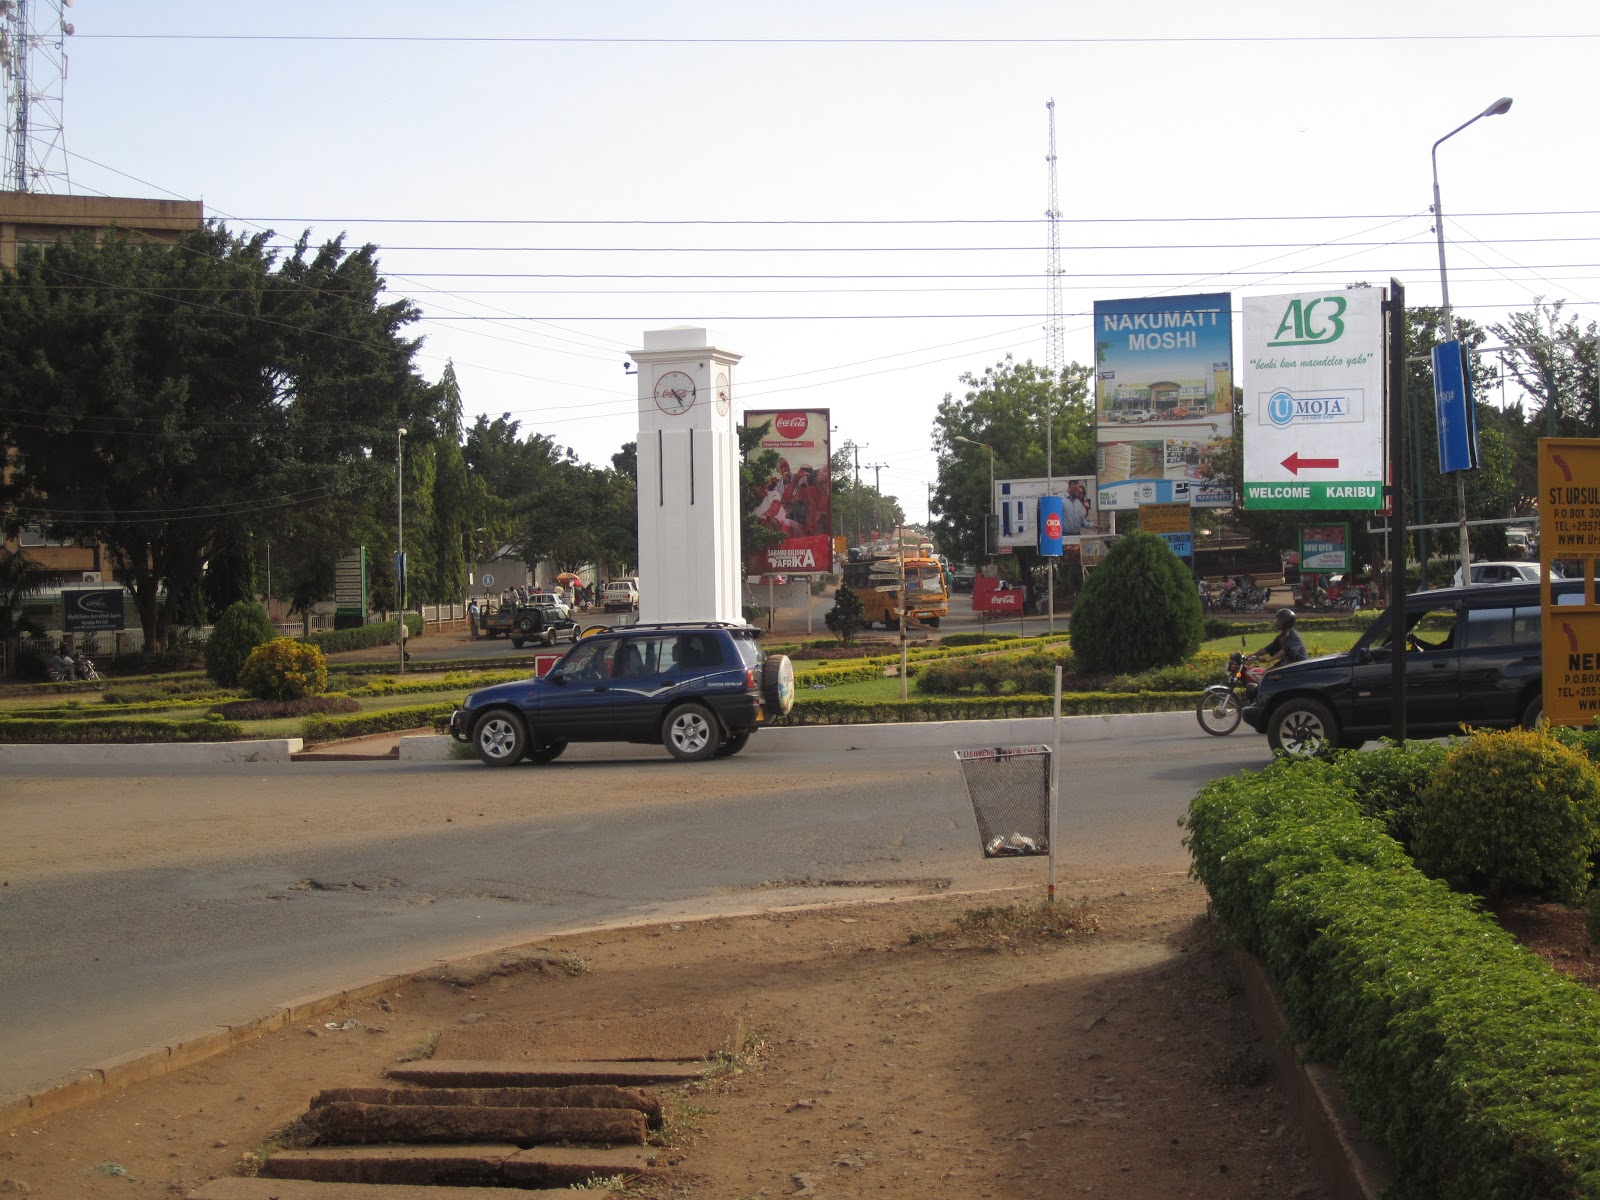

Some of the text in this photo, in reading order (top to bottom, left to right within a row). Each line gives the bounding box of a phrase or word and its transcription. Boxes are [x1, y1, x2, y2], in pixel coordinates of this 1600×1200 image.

[1104, 309, 1220, 331] NAKUMATT
[1129, 332, 1196, 350] MOSHI
[1280, 358, 1297, 368] kwa
[1249, 486, 1376, 498] WELCOME KARIBU
[1318, 544, 1332, 552] OPEN
[777, 549, 816, 568] AFRIKA
